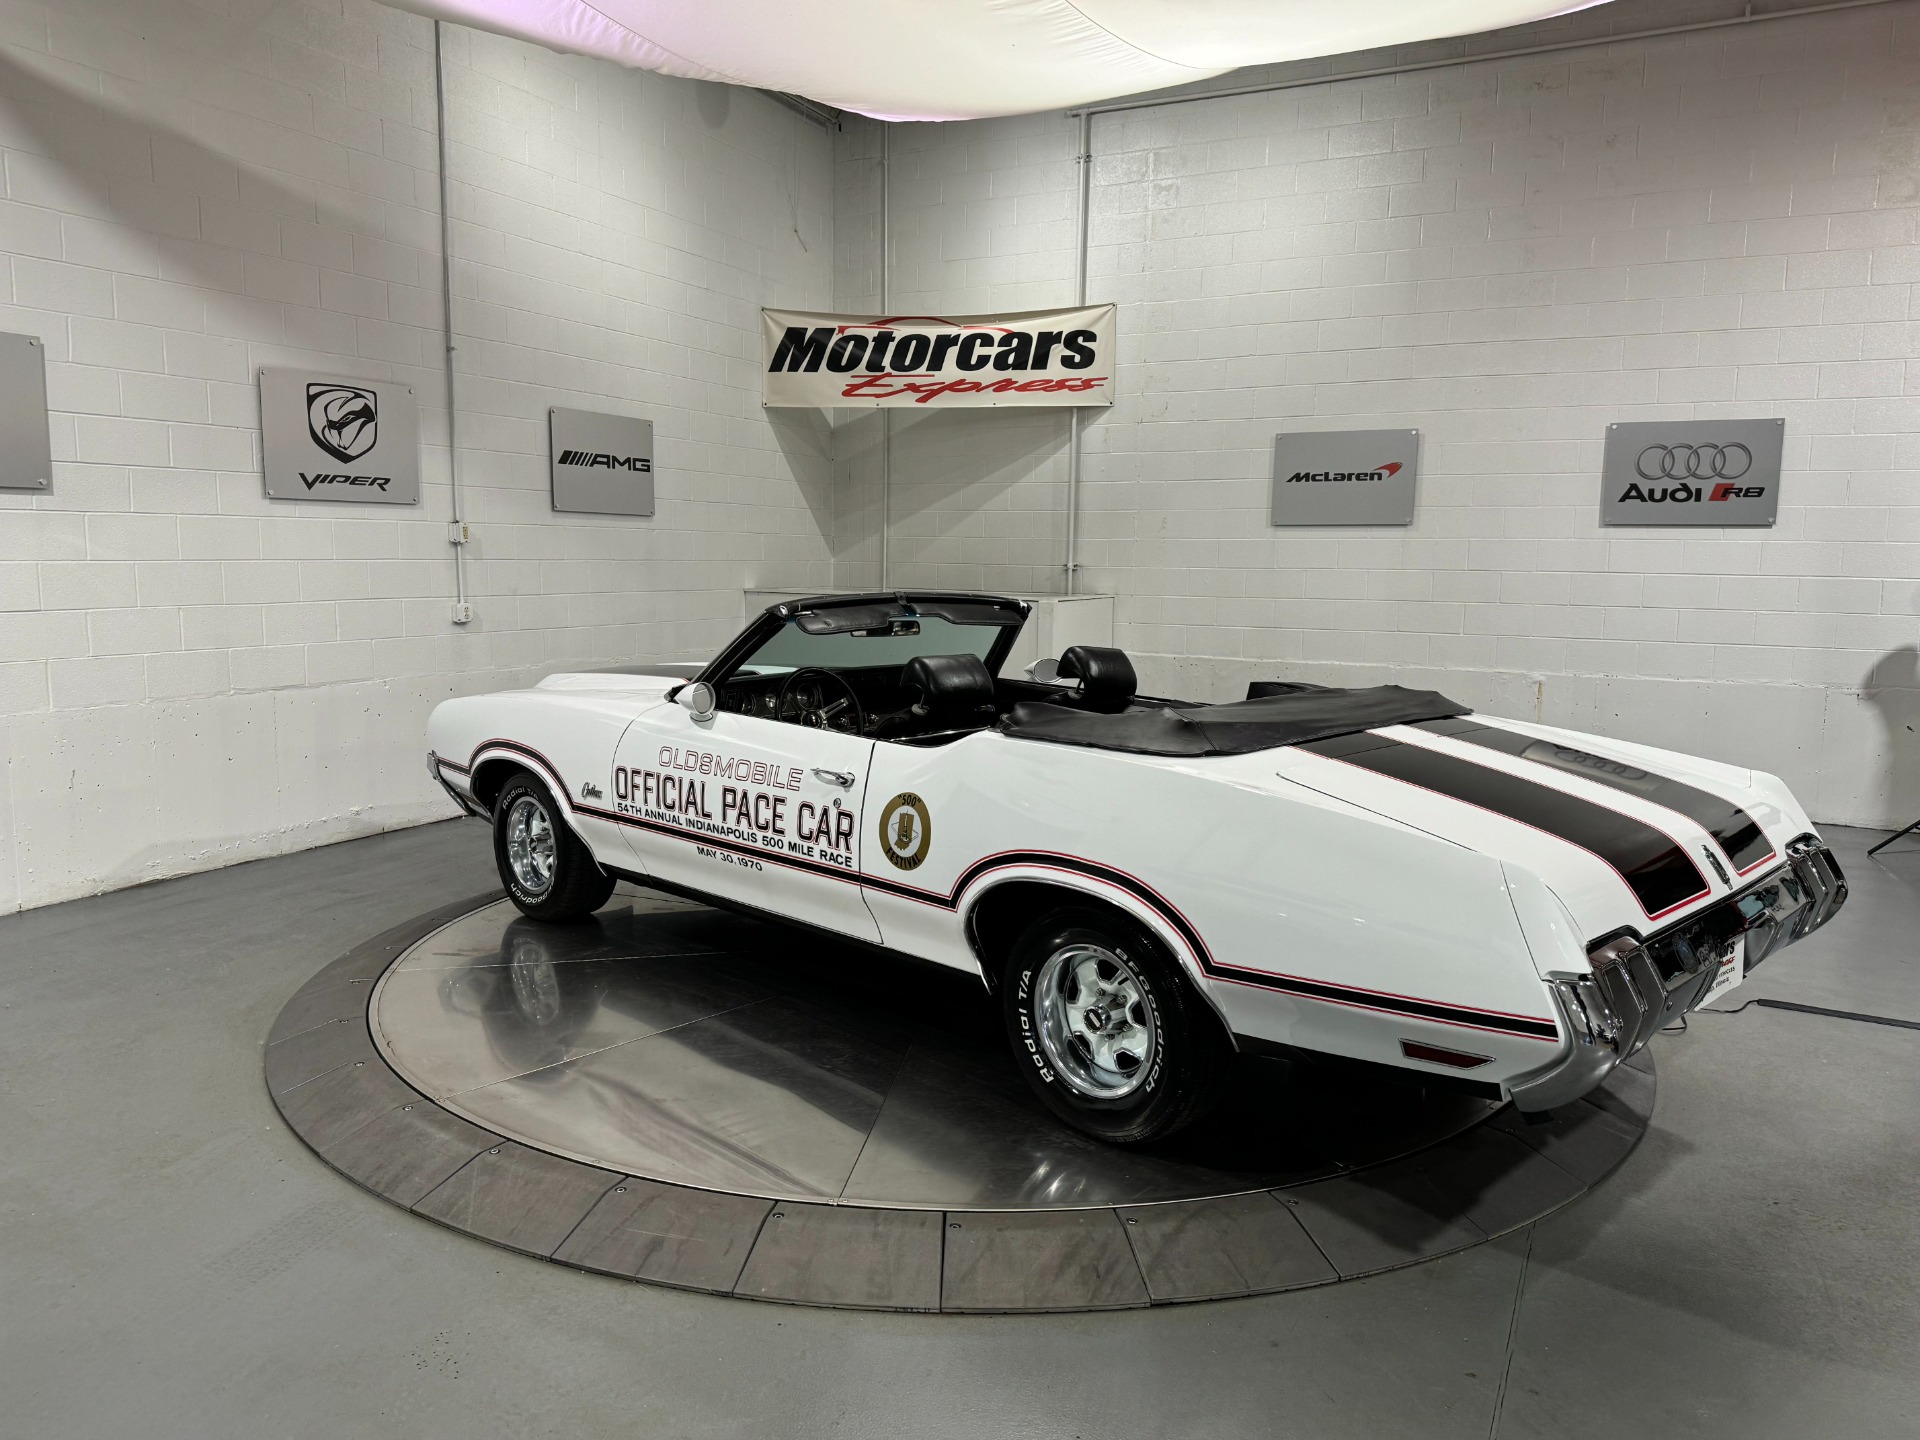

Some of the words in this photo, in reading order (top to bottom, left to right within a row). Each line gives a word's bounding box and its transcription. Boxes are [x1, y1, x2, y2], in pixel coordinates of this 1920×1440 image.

[768, 326, 1098, 373] Motorcars
[841, 372, 1109, 403] Express
[298, 472, 391, 492] VIPER
[1285, 471, 1383, 483] McLaren
[1618, 482, 1702, 503] Audi
[1720, 486, 1765, 498] R8
[659, 746, 804, 791] OLDSMOBILE
[615, 765, 712, 820] OFFICIAL
[722, 785, 787, 837] PACE
[797, 800, 854, 854] CAR
[617, 802, 642, 816] 54TH
[644, 808, 683, 826] ANNUAL
[685, 817, 758, 843] INDIANAPOLIS
[762, 835, 784, 851] 500
[788, 840, 815, 858] MILE
[820, 849, 853, 868] RACE
[696, 846, 717, 859] MAY
[886, 846, 922, 869] FESTIVAL
[1018, 970, 1032, 1000] T/A
[1018, 1008, 1055, 1084] Radial
